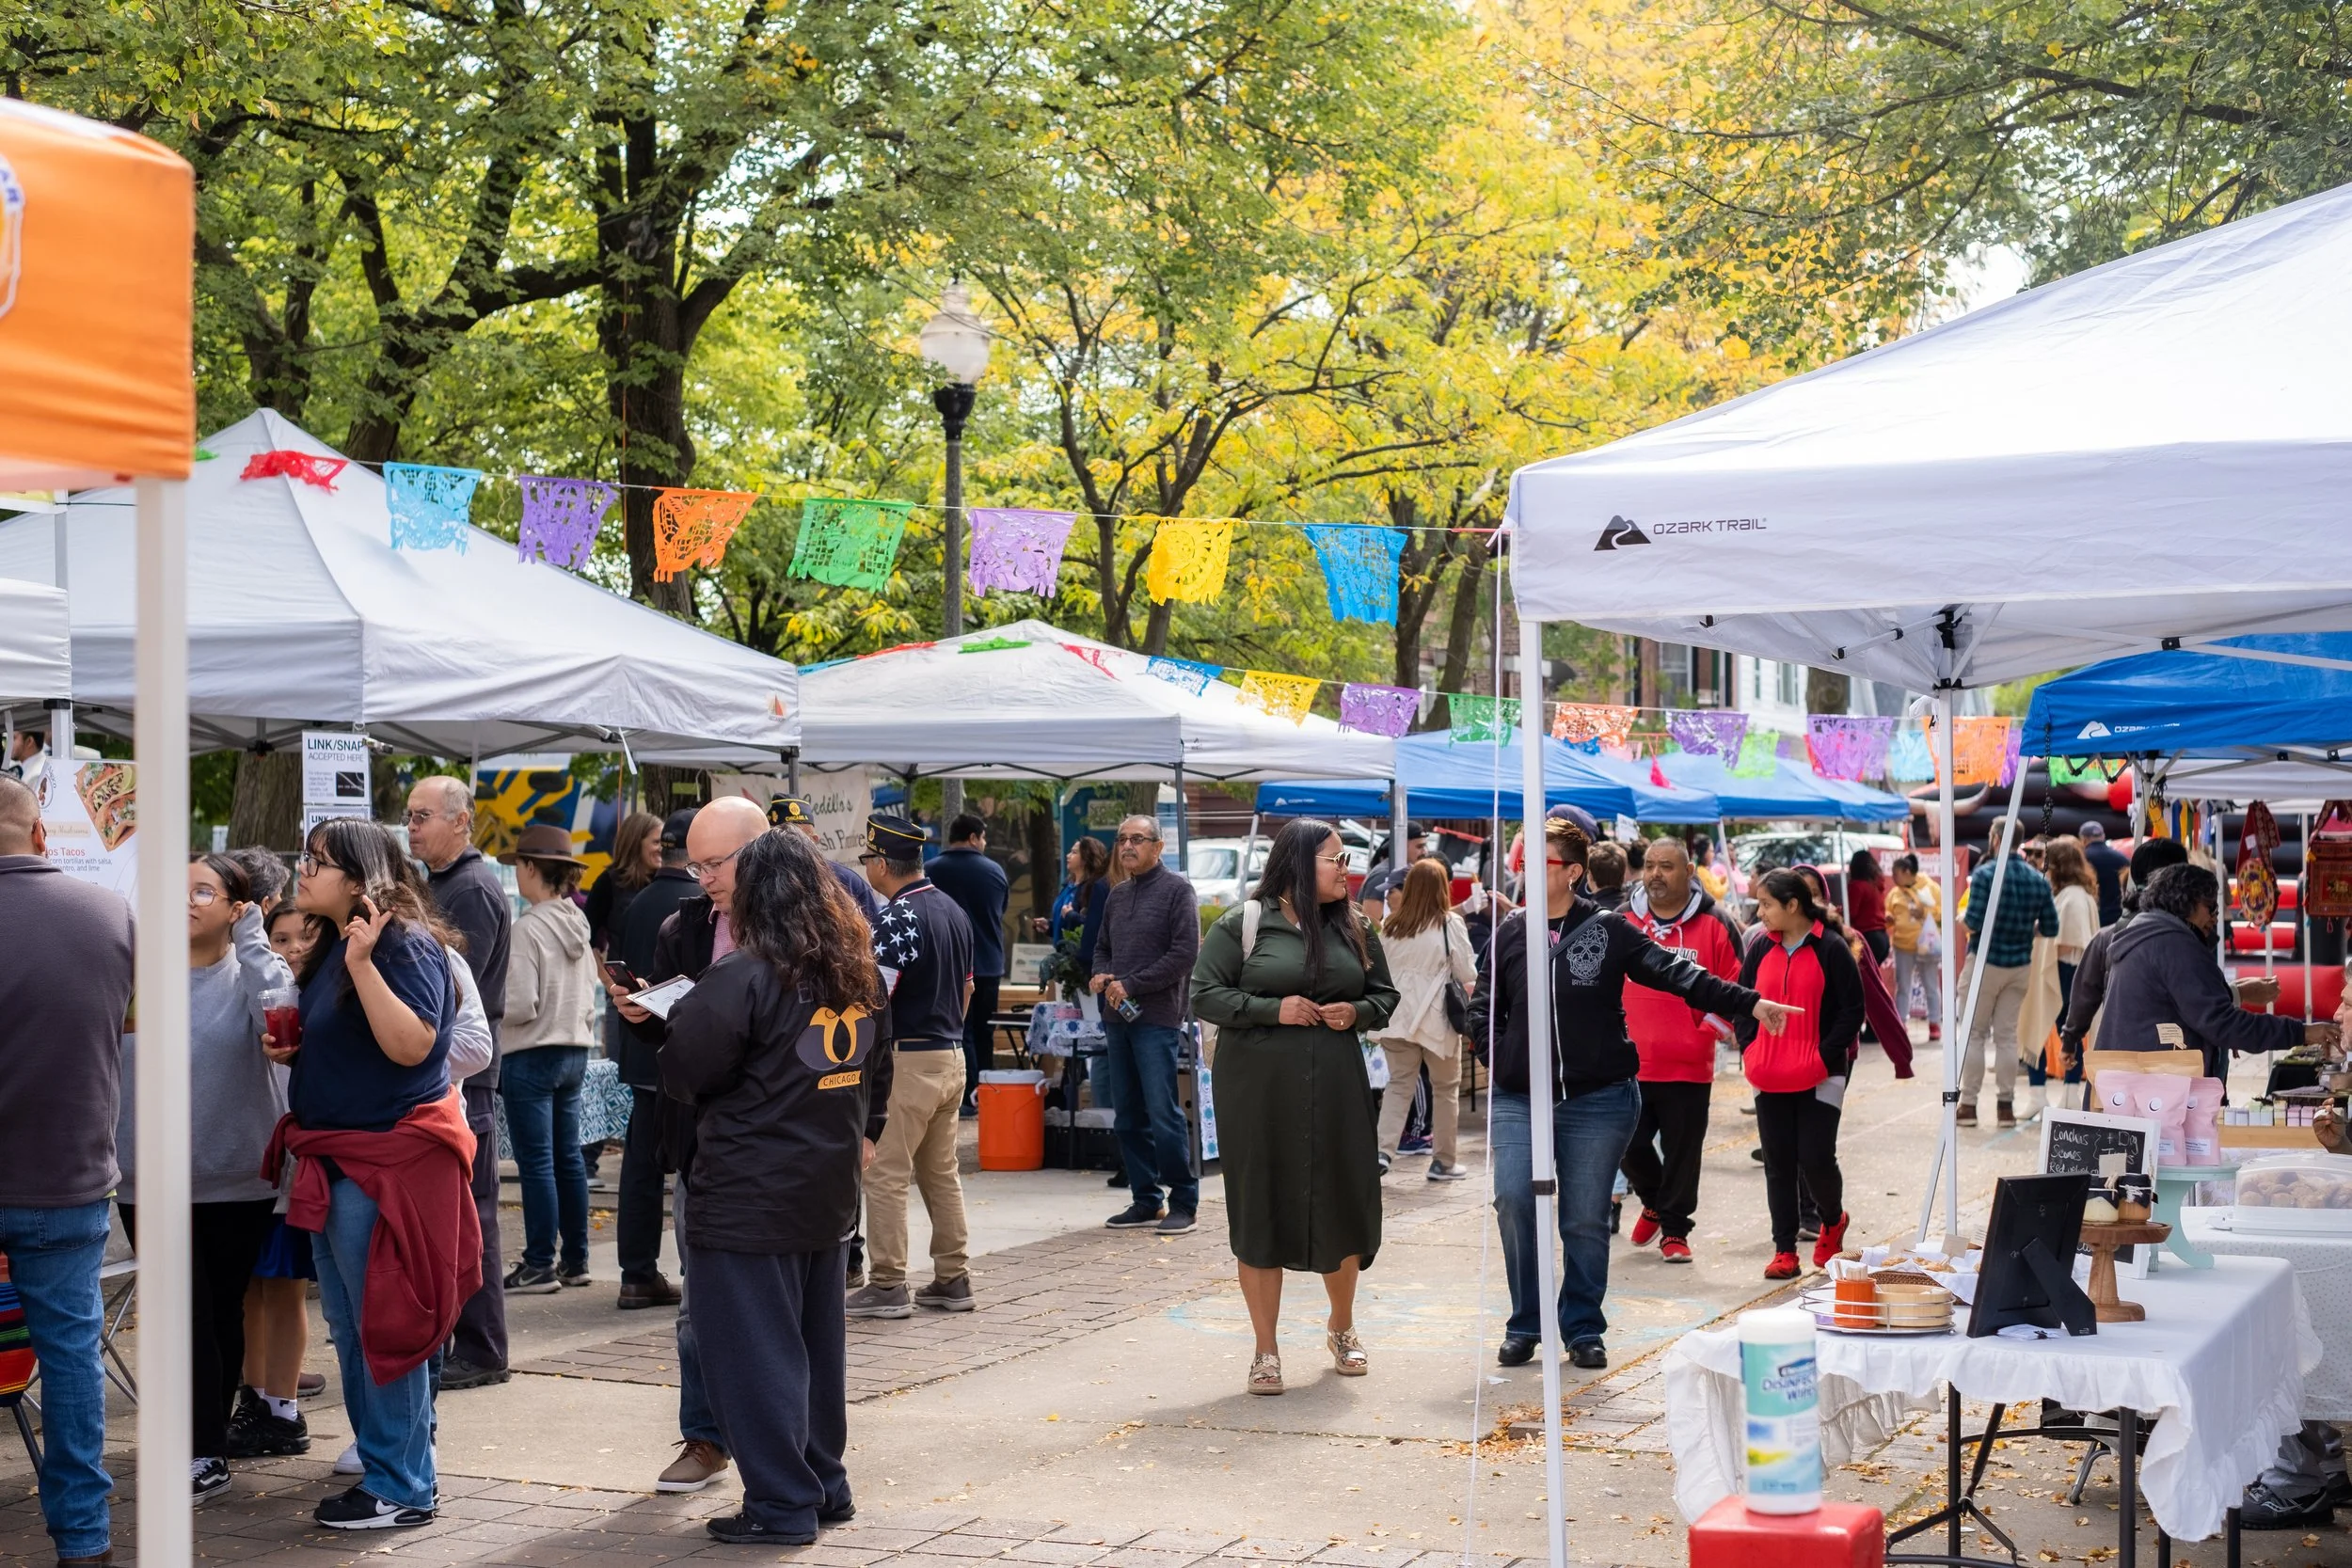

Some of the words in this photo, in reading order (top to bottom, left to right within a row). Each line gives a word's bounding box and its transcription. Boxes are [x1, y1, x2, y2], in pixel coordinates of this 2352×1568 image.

[1653, 520, 1713, 535] OZARK
[1715, 518, 1767, 531] TRAIL
[307, 738, 363, 752] LINK/SNAP
[308, 752, 345, 762] ACCEPTED
[346, 753, 364, 762] HERE
[60, 847, 86, 857] Tacos
[823, 1073, 856, 1086] CHICAGO
[2118, 1131, 2139, 1156] Dog
